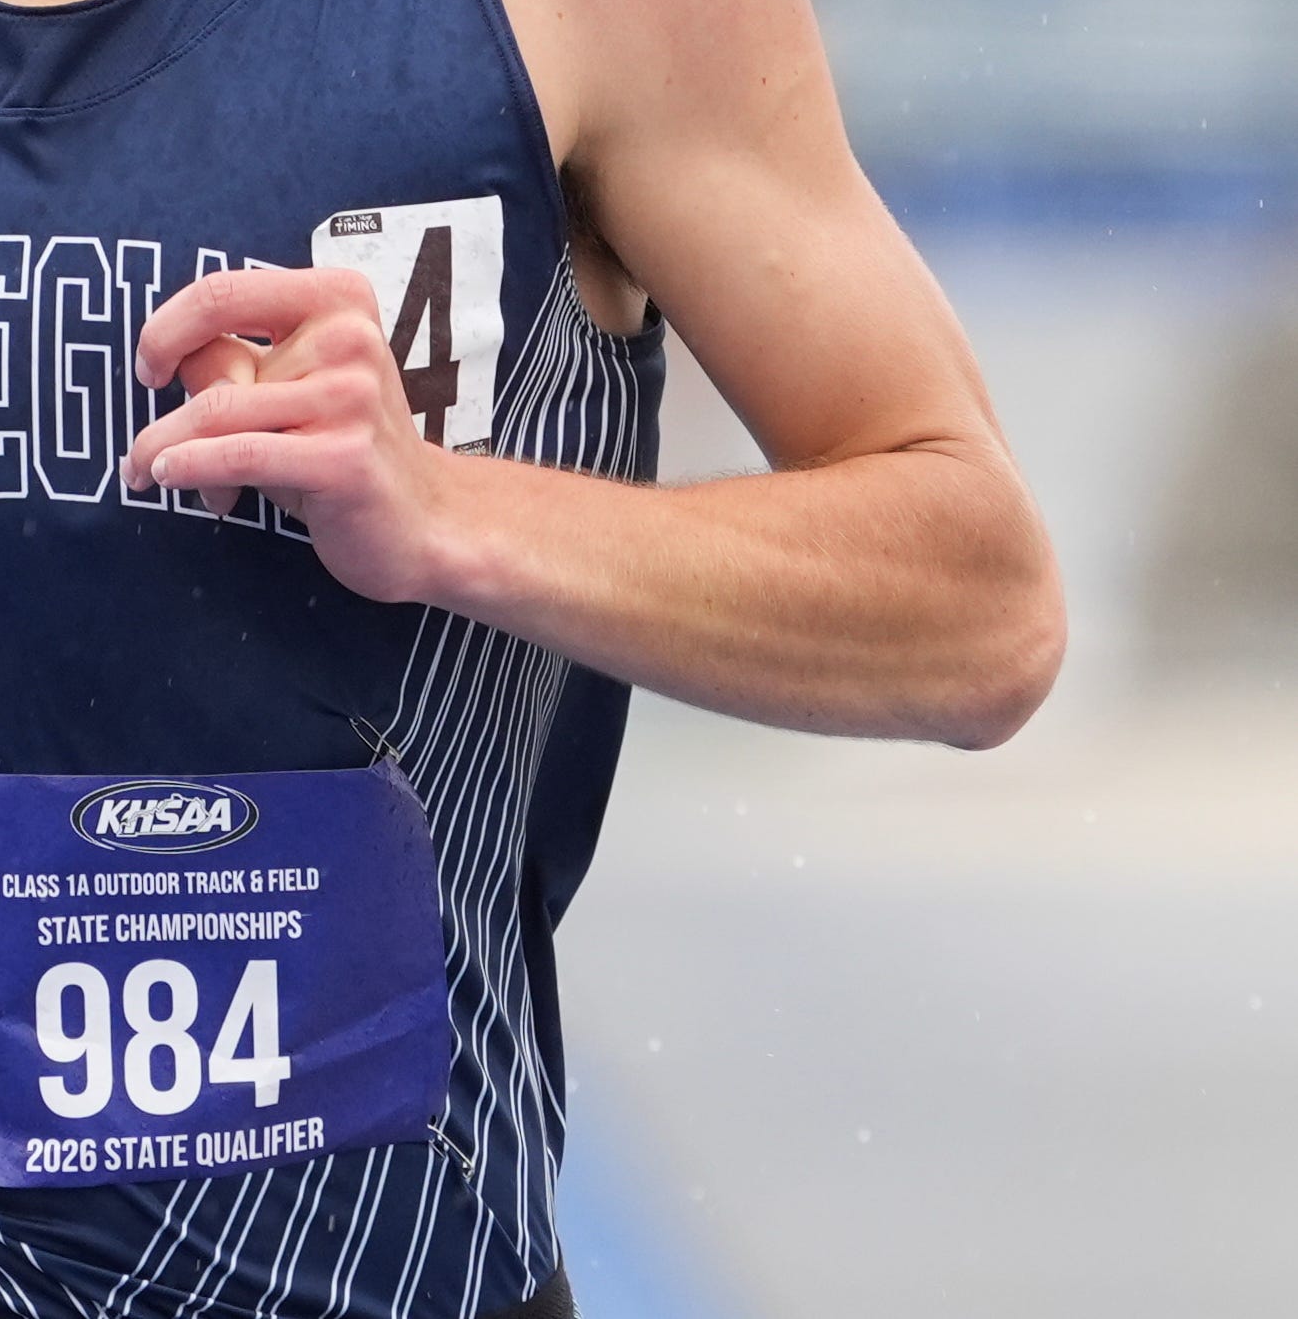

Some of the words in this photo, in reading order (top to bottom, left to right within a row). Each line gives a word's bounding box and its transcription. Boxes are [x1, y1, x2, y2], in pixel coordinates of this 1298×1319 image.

[335, 220, 378, 233] TIMING
[389, 225, 461, 447] 4
[96, 793, 232, 837] KHSAA
[2, 873, 60, 898] CLASS
[66, 873, 90, 897] 1A
[94, 872, 180, 896] OUTDOOR
[184, 869, 246, 894] TRACK
[250, 869, 263, 893] &
[268, 867, 320, 892] FIELD
[38, 914, 110, 946] STATE
[115, 910, 302, 943] CHAMPIONSHIPS
[35, 959, 291, 1118] 984
[26, 1138, 98, 1173] 2026
[104, 1134, 189, 1171] STATE
[196, 1117, 324, 1168] QUALIFIER
